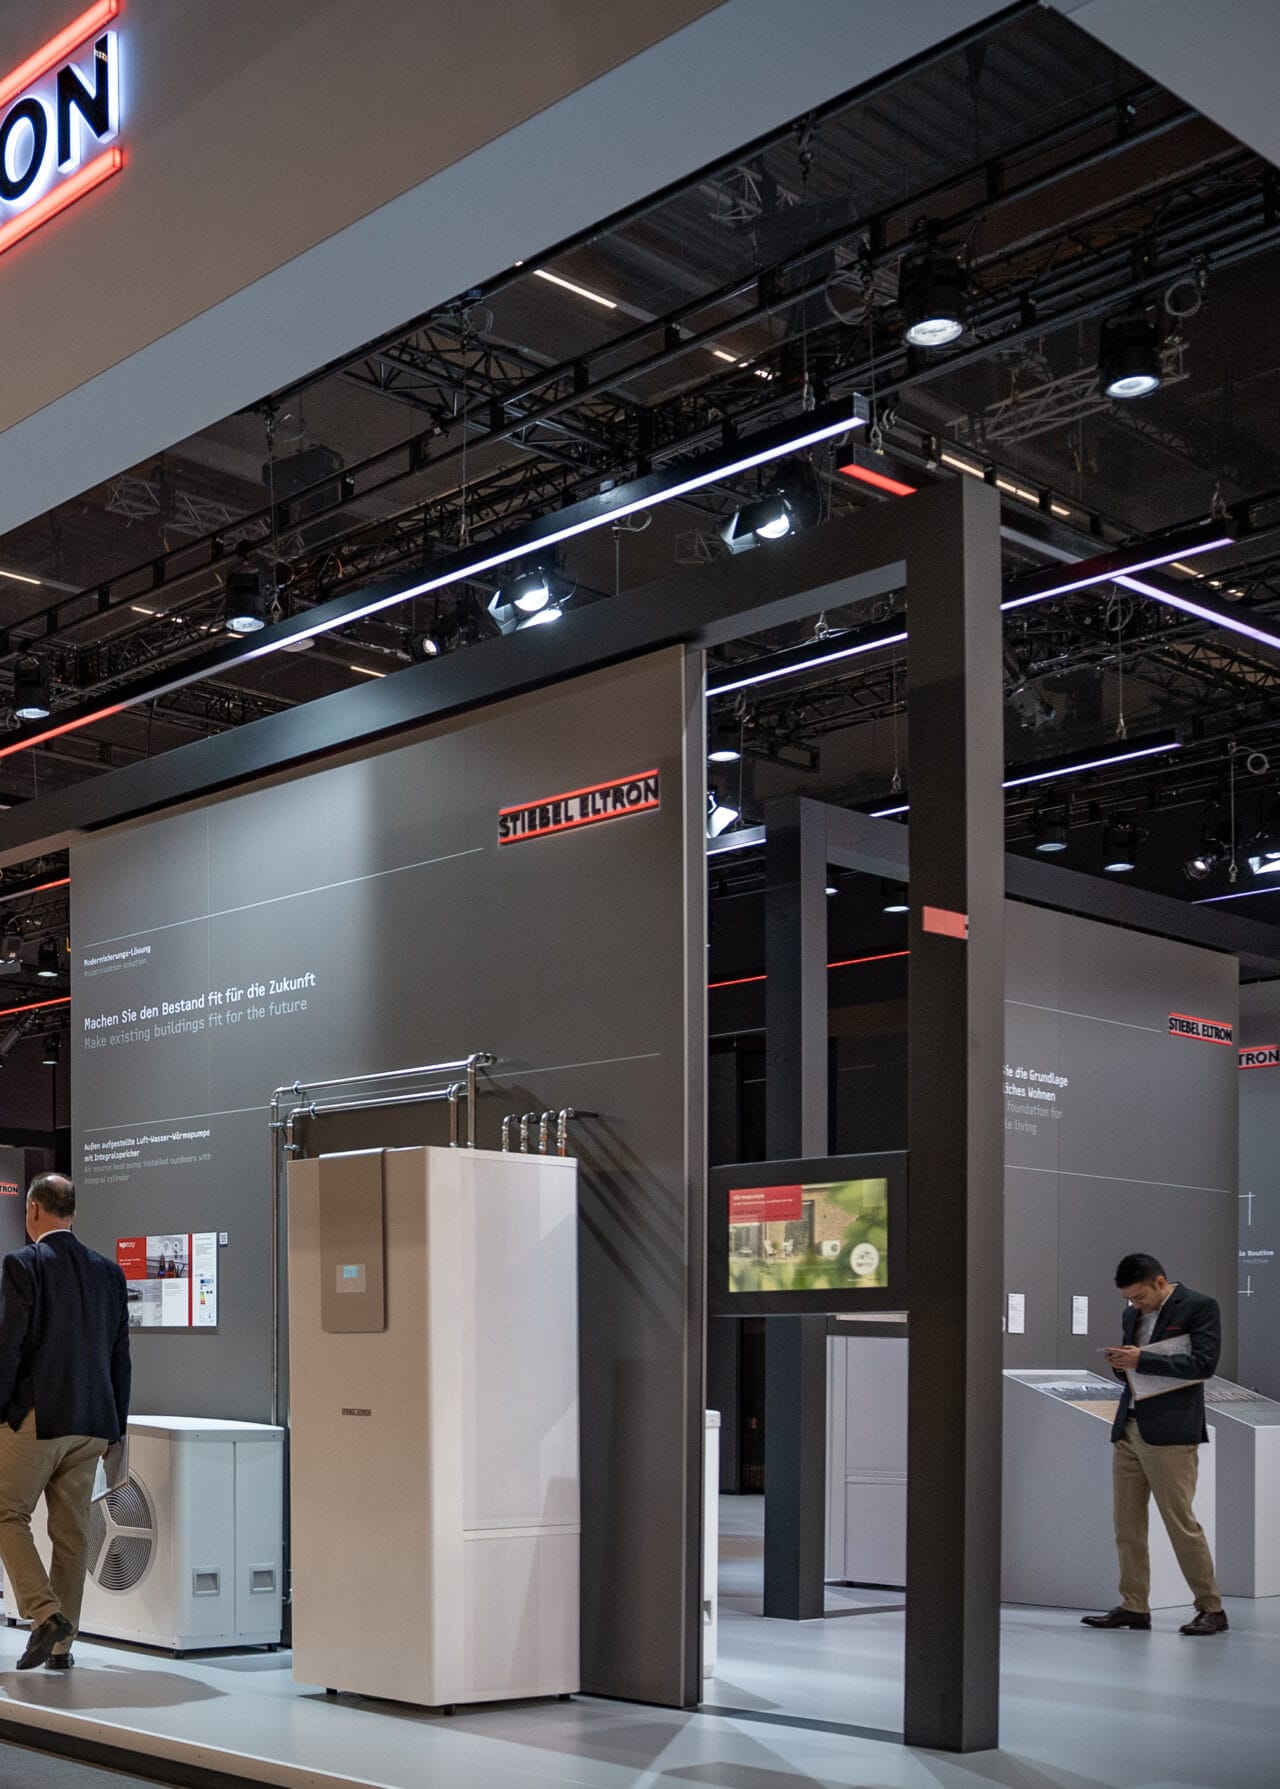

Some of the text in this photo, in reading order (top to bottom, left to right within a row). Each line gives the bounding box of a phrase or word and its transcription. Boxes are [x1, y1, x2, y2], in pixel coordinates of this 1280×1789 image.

[499, 777, 659, 838] STIEBEL ELTRON
[83, 945, 151, 967] Modernisierungs-Lösung
[84, 971, 317, 1031] Machen Sie den Bestand fit für die Zukunft
[84, 998, 308, 1050] Make existing buildings fit for the future
[1168, 1017, 1232, 1042] STIEBEL ELTRON
[1015, 1066, 1028, 1080] die
[1029, 1069, 1068, 1088] Grundlage
[1027, 1086, 1056, 1101] Wohnen
[84, 1142, 101, 1152] Außen
[101, 1137, 135, 1150] aufgestellte
